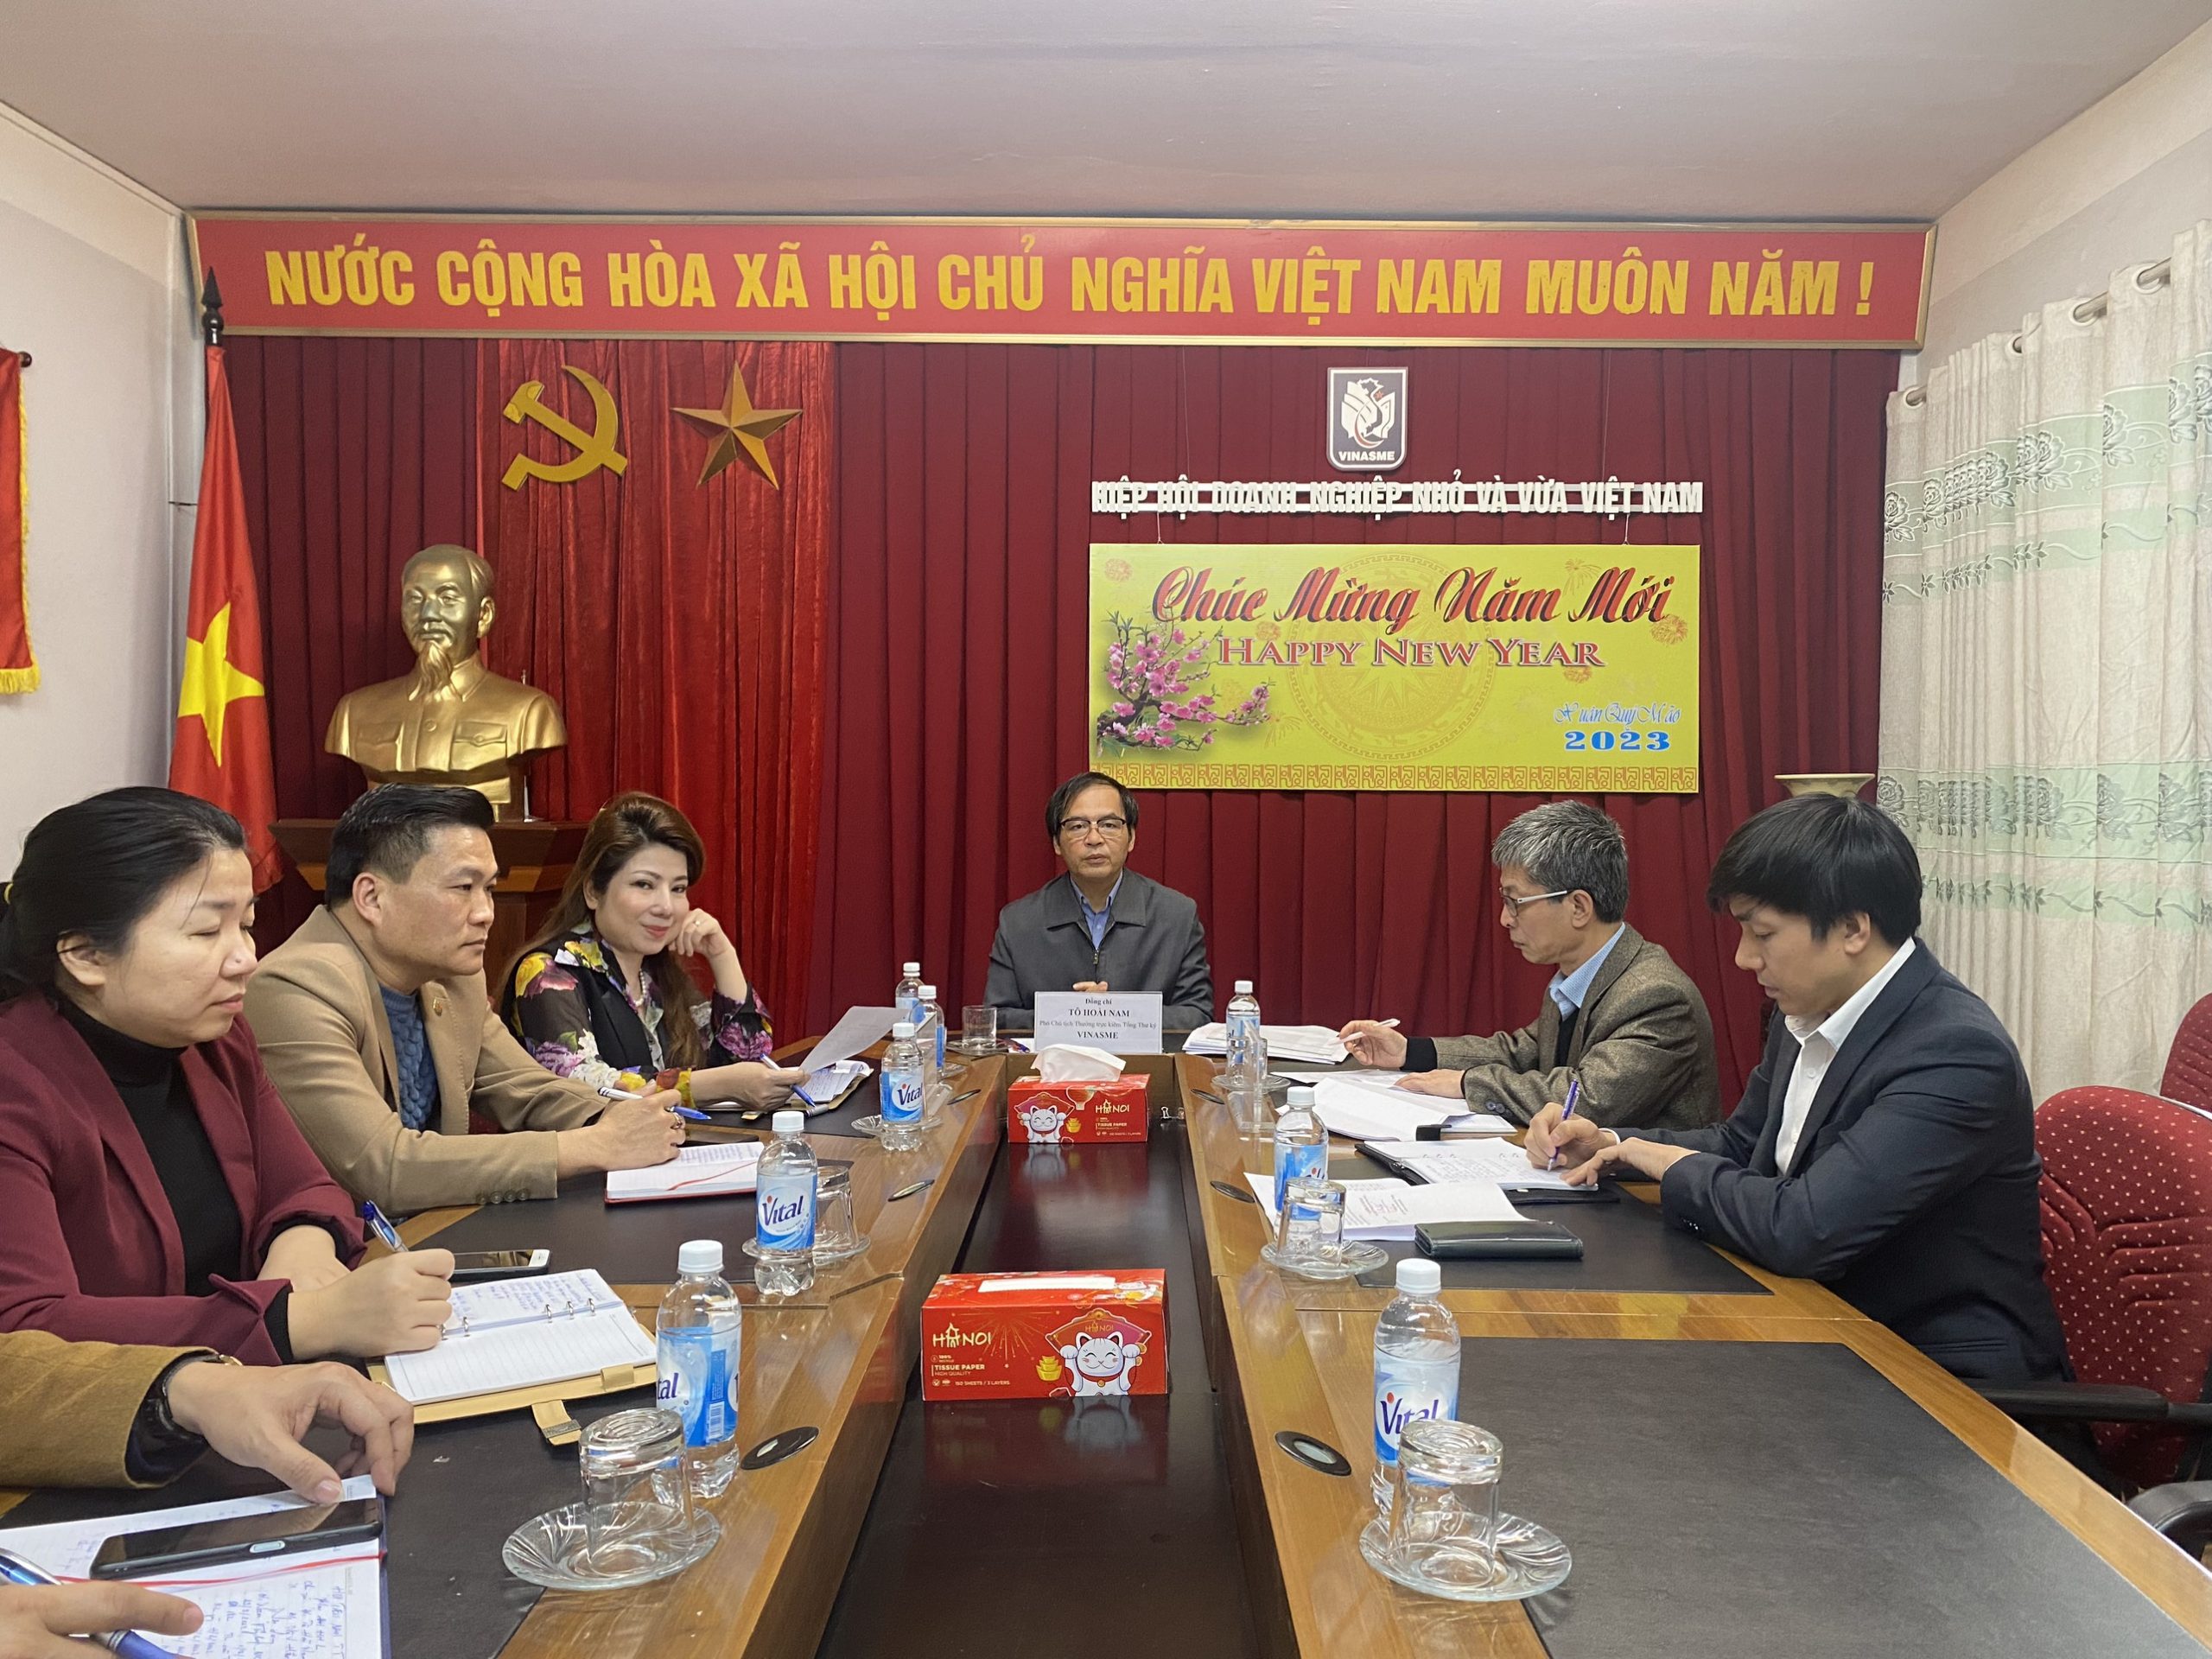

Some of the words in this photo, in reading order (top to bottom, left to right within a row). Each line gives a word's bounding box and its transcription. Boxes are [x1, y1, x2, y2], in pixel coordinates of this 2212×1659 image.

[267, 235, 414, 305] NƯỚC
[437, 239, 582, 317] CỘNG
[608, 242, 715, 307] HÒA
[736, 243, 807, 308] XÃ
[830, 242, 916, 321] HỘI
[938, 235, 1043, 311] CHỦ
[1072, 248, 1233, 313] NGHĨA
[1253, 247, 1361, 325] VIỆT
[1377, 259, 1501, 314] NAM
[1526, 248, 1688, 315] MUÔN
[1710, 251, 1839, 315] NĂM
[1857, 263, 1873, 315] !
[1338, 451, 1395, 461] VINASME
[1092, 475, 1147, 520] HIỆP
[1157, 474, 1199, 520] HỘI
[1211, 480, 1297, 513] DOANH
[1310, 475, 1402, 521] NGHIỆP
[1412, 469, 1464, 513] NHỎ
[1476, 474, 1508, 513] VÀ
[1517, 474, 1576, 514] VỪA
[1580, 476, 1634, 520] VIỆT
[1642, 481, 1704, 513] NAM
[1152, 566, 1268, 623] Chúc
[1273, 566, 1420, 635] Mừng
[1433, 566, 1562, 623] Năm
[1567, 566, 1675, 623] Mới
[1217, 636, 1363, 667] HAPPY
[1373, 637, 1490, 666] NEW
[1488, 637, 1606, 667] YEAR
[1565, 731, 1670, 751] 2023
[1084, 1007, 1106, 1017] HOÀI
[1077, 1031, 1119, 1039] VINASME
[897, 1082, 924, 1106] Vital
[1095, 1098, 1130, 1115] HANOI
[762, 1195, 804, 1226] Vital
[932, 1322, 992, 1348] HANOI
